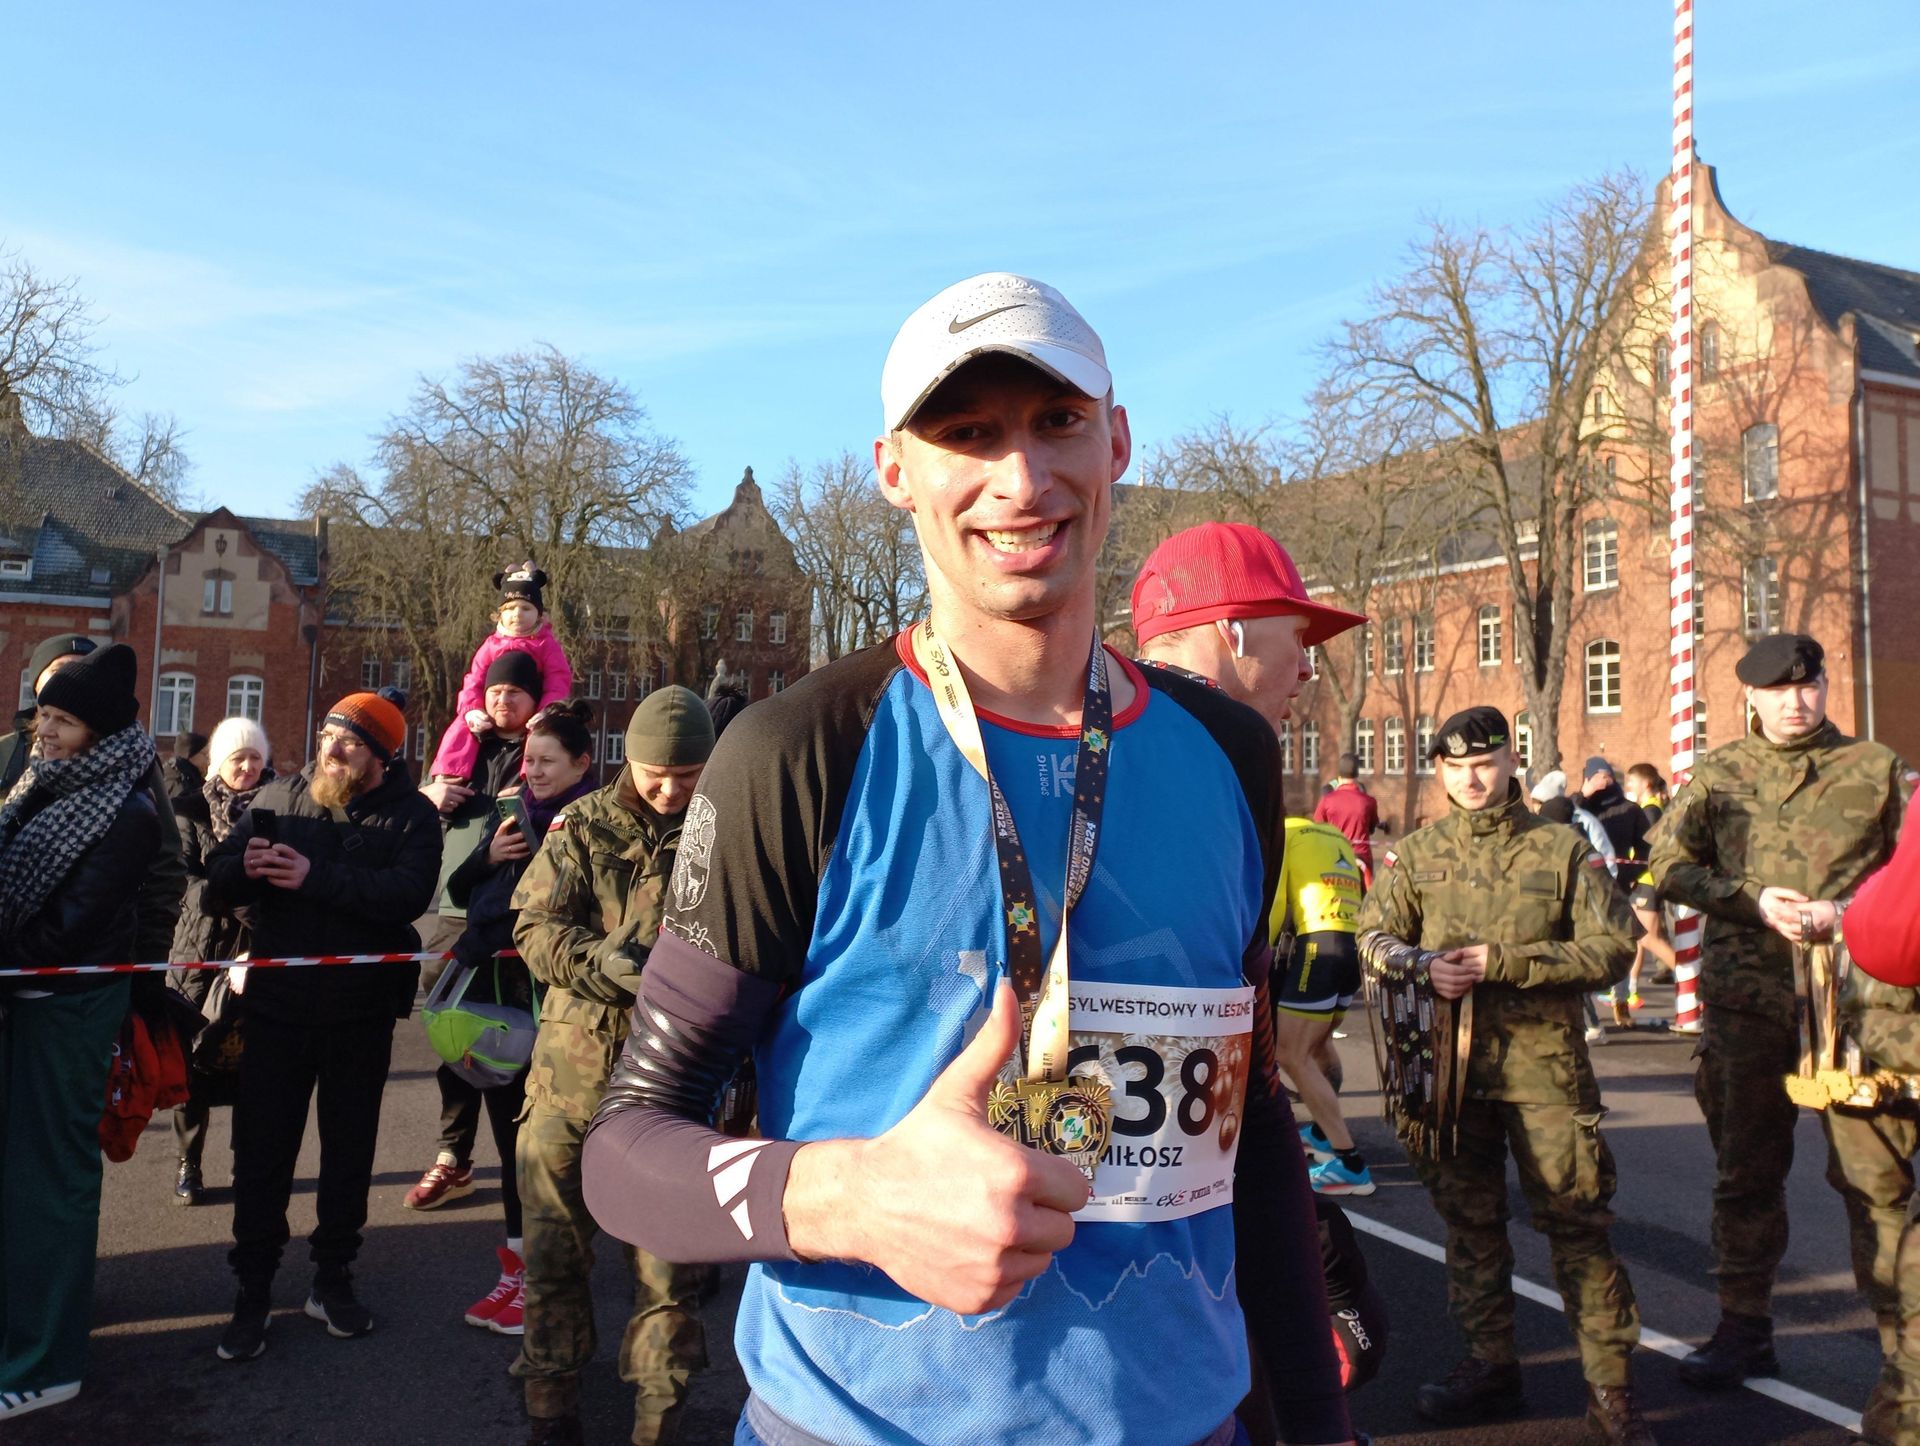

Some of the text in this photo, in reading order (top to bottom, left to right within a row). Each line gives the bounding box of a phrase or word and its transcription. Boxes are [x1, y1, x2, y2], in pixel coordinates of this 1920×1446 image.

[995, 804, 1008, 838] 2024
[1084, 821, 1097, 855] 2024
[1069, 997, 1197, 1018] SYLWESTROWY
[1203, 1003, 1215, 1018] W
